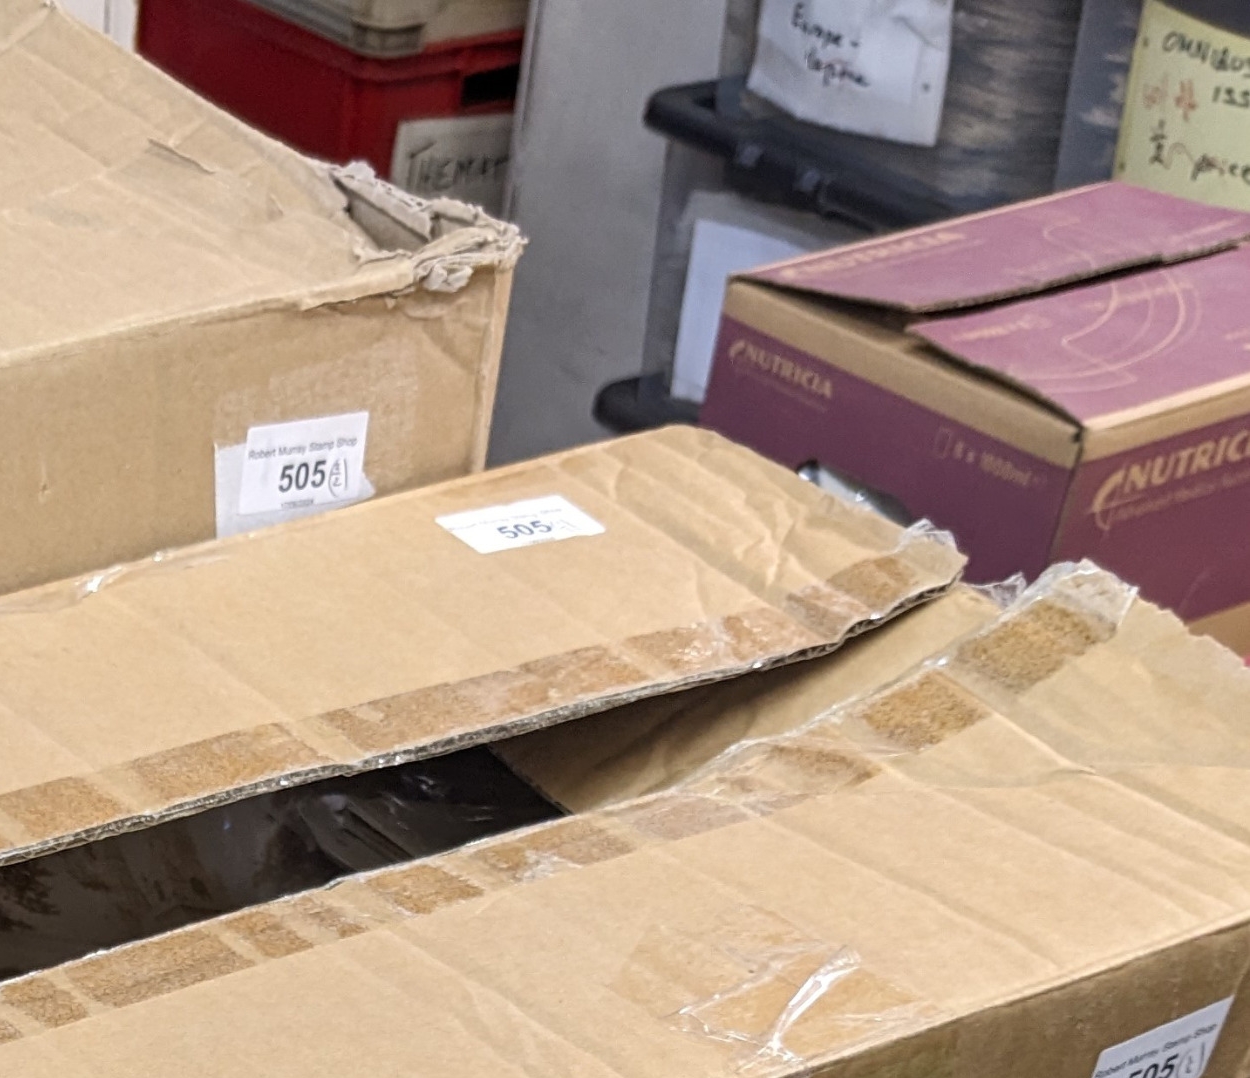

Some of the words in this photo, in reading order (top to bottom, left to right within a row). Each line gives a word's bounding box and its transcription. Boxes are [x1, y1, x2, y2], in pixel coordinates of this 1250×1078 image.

[742, 341, 833, 400] NUTRICIA
[248, 447, 276, 459] Robert
[277, 444, 307, 456] Murray
[309, 441, 334, 452] Stamp
[336, 437, 357, 448] Shop
[278, 459, 327, 493] 505
[497, 519, 553, 539] 505
